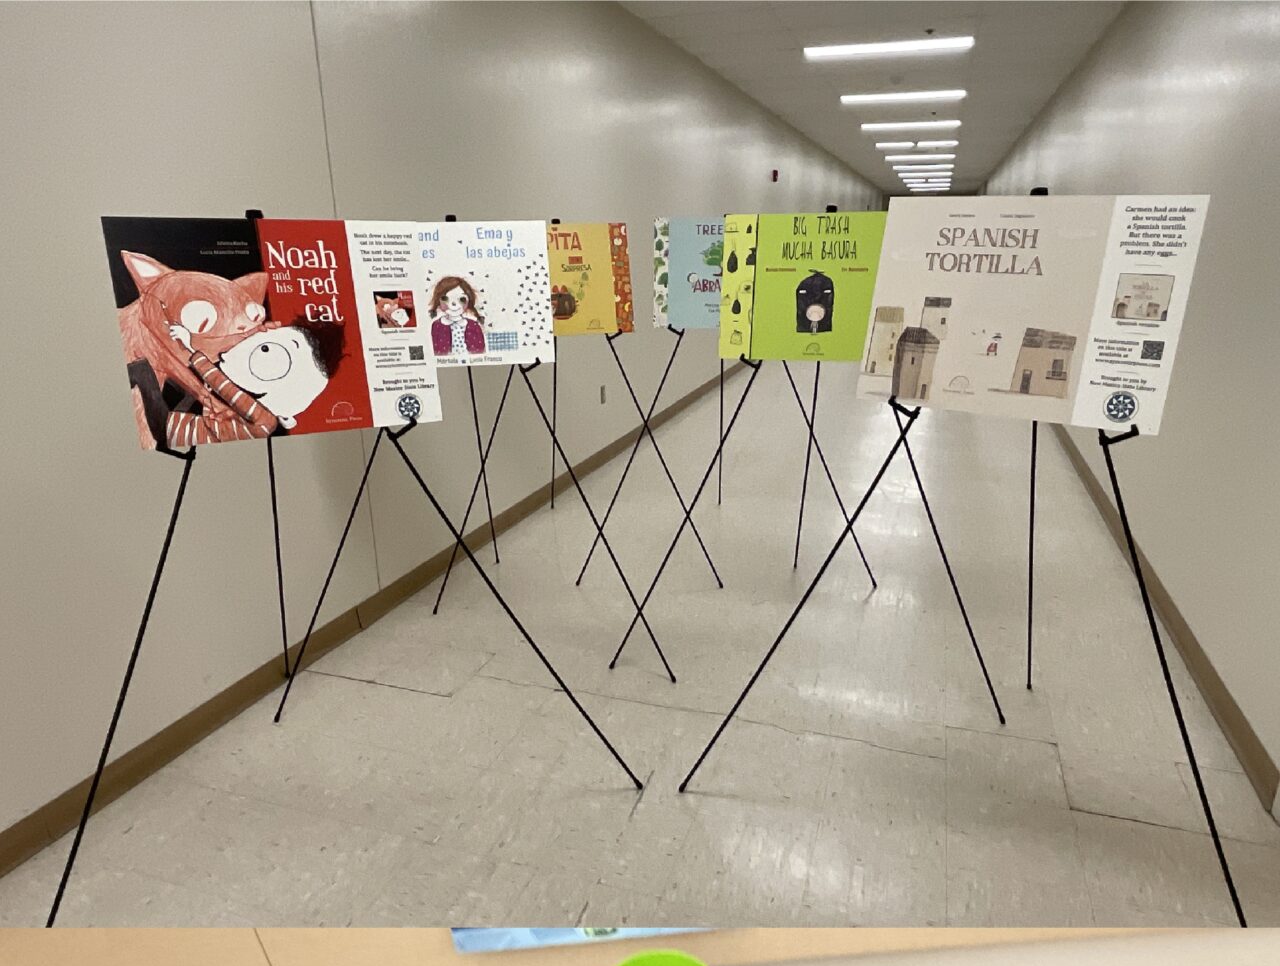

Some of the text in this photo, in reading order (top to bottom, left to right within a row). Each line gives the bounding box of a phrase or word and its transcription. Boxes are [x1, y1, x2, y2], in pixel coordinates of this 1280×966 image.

[1124, 205, 1153, 213] Carmen
[1153, 205, 1167, 213] had
[1145, 214, 1167, 222] would
[476, 227, 503, 239] Ema
[506, 230, 513, 241] y
[793, 215, 850, 237] BIG TRASH
[1132, 223, 1160, 231] Spanish
[936, 226, 1041, 249] SPANISH
[265, 240, 338, 270] Noah
[422, 243, 526, 260] es las abejas
[781, 240, 857, 261] MUCHA BASURA
[925, 252, 1043, 276] TORTILLA
[272, 271, 291, 281] and
[276, 270, 340, 296] his red
[692, 279, 722, 293] ABRA
[305, 295, 344, 323] cat
